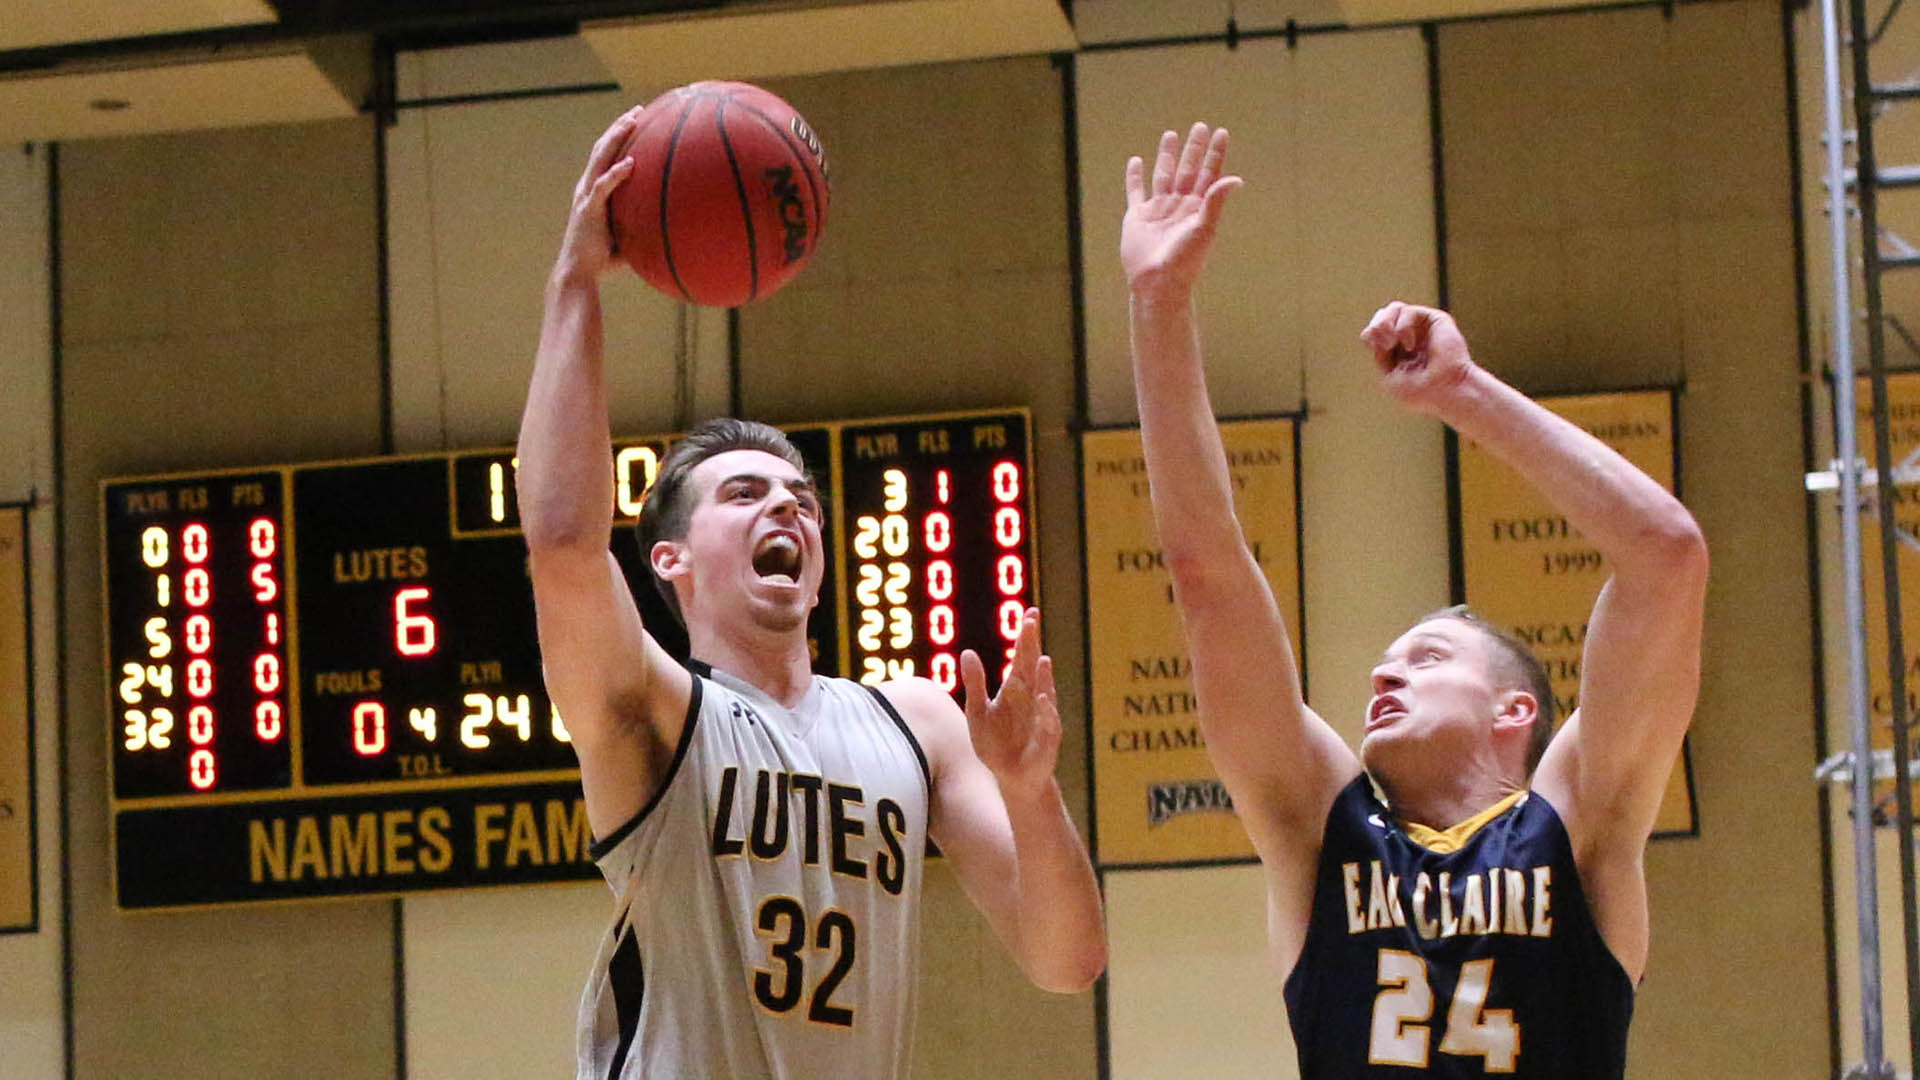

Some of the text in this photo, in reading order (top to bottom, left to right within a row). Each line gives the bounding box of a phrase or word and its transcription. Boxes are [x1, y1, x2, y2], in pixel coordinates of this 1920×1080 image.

[765, 165, 807, 262] NCAA
[973, 424, 1006, 448] PTS
[883, 461, 1019, 512] 3 1 0
[142, 519, 275, 567] 0 0 0
[854, 507, 1021, 559] 20 0 0
[157, 563, 276, 607] 1 0 5
[334, 546, 428, 583] LUTES
[856, 555, 1023, 606] 22 0 0
[145, 613, 278, 658] 5 0 1
[395, 588, 435, 656] 6
[858, 607, 913, 651] 23
[929, 605, 954, 645] 0
[1000, 599, 1024, 640] 0
[120, 654, 279, 704] 24 0 0
[315, 660, 502, 694] FOULS PLYR
[931, 653, 956, 692] 0
[124, 701, 280, 751] 32 0 0
[354, 702, 386, 754] 0
[409, 707, 436, 742] 4
[460, 693, 531, 749] 24
[190, 750, 214, 788] 0
[248, 799, 594, 884] NAMES FAM
[713, 766, 907, 896] LUTES
[1412, 865, 1554, 940] CLAIRE
[753, 894, 856, 1028] 32
[1368, 947, 1521, 1074] 24
